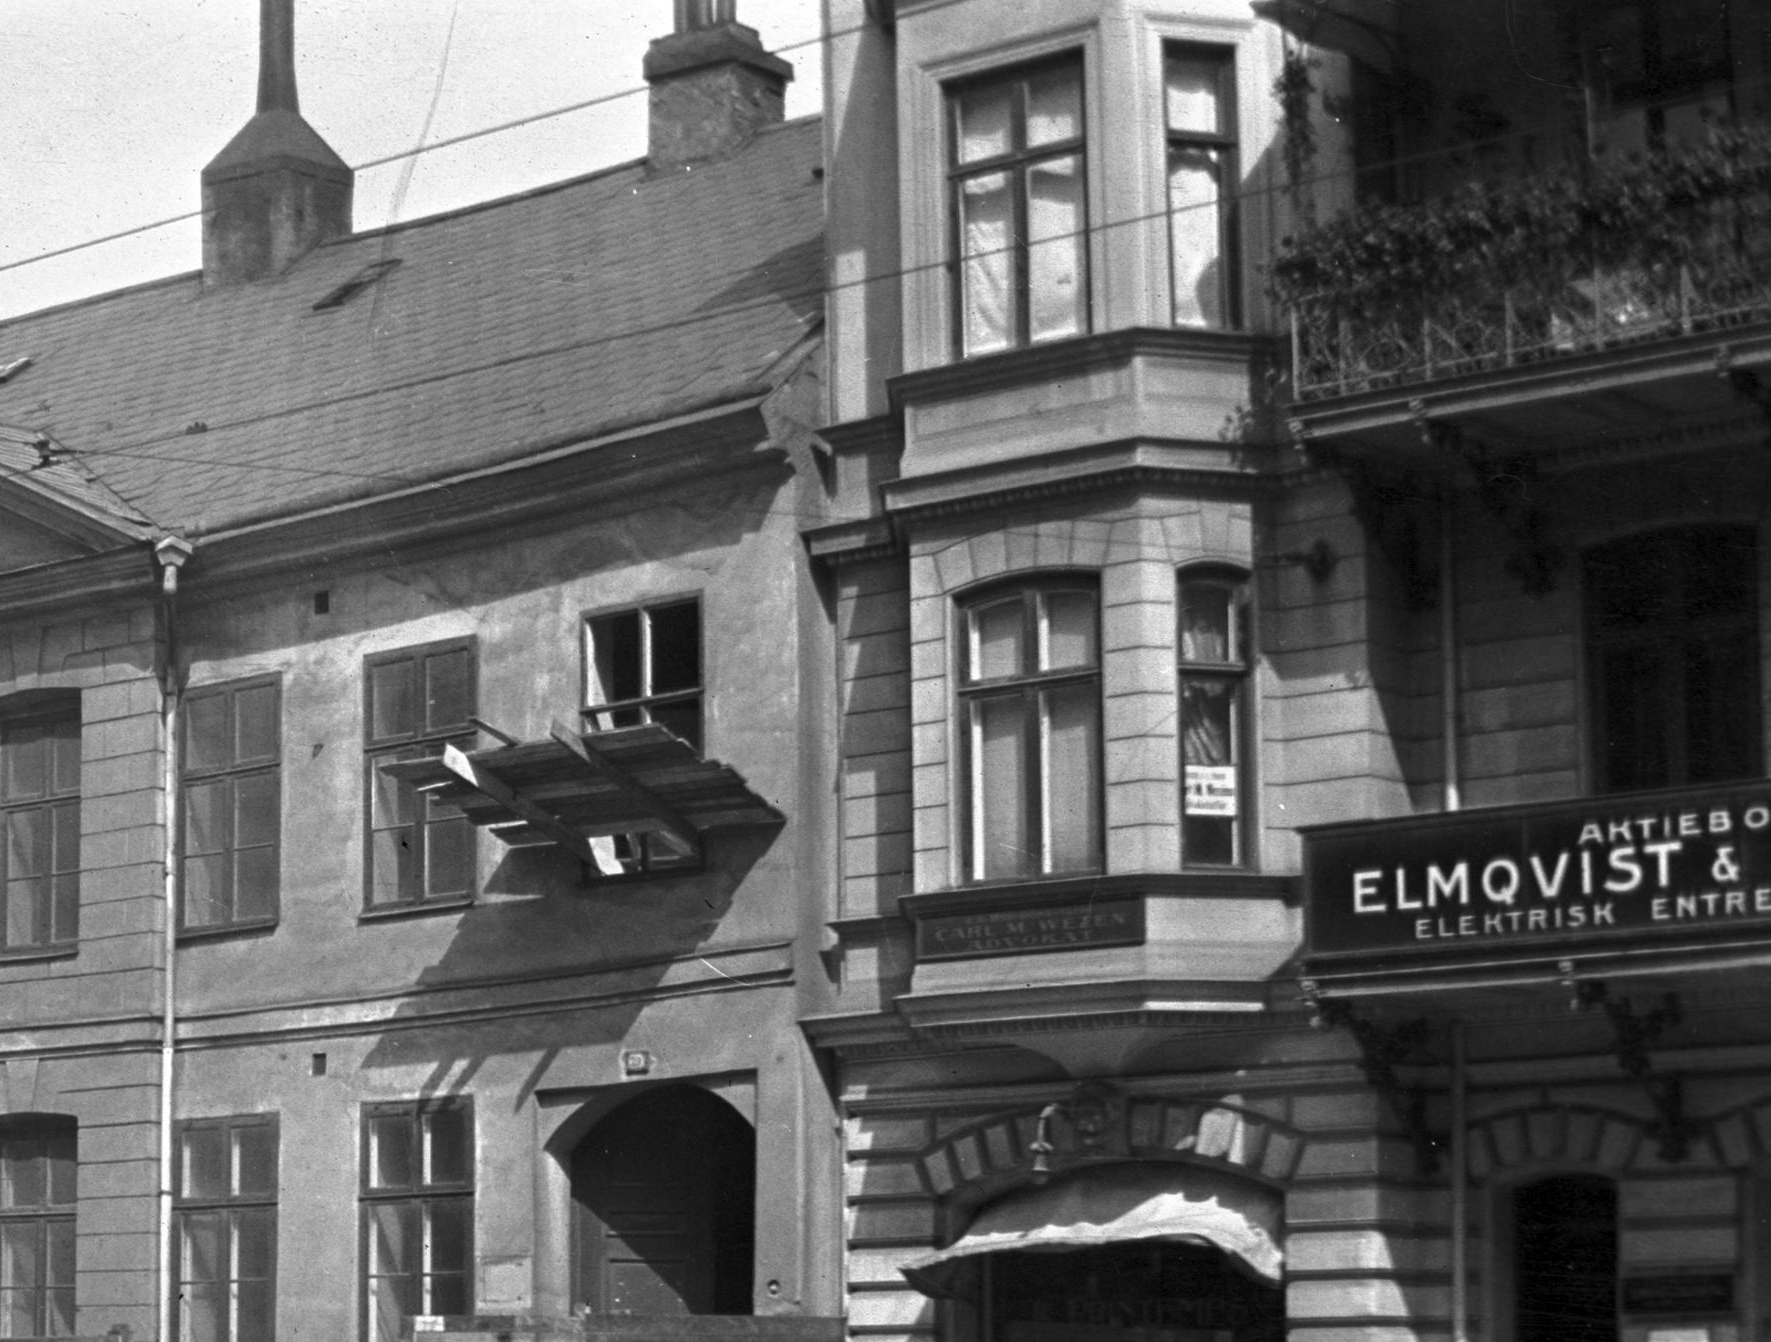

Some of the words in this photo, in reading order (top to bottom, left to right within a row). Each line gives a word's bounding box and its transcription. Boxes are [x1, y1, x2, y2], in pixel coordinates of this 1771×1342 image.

[1578, 806, 1771, 845] AKTIEBO
[1352, 841, 1683, 914] ELMQVIST
[1711, 846, 1741, 882] &
[1415, 902, 1615, 939] ELEKTRISK
[1651, 888, 1771, 920] ENTRE
